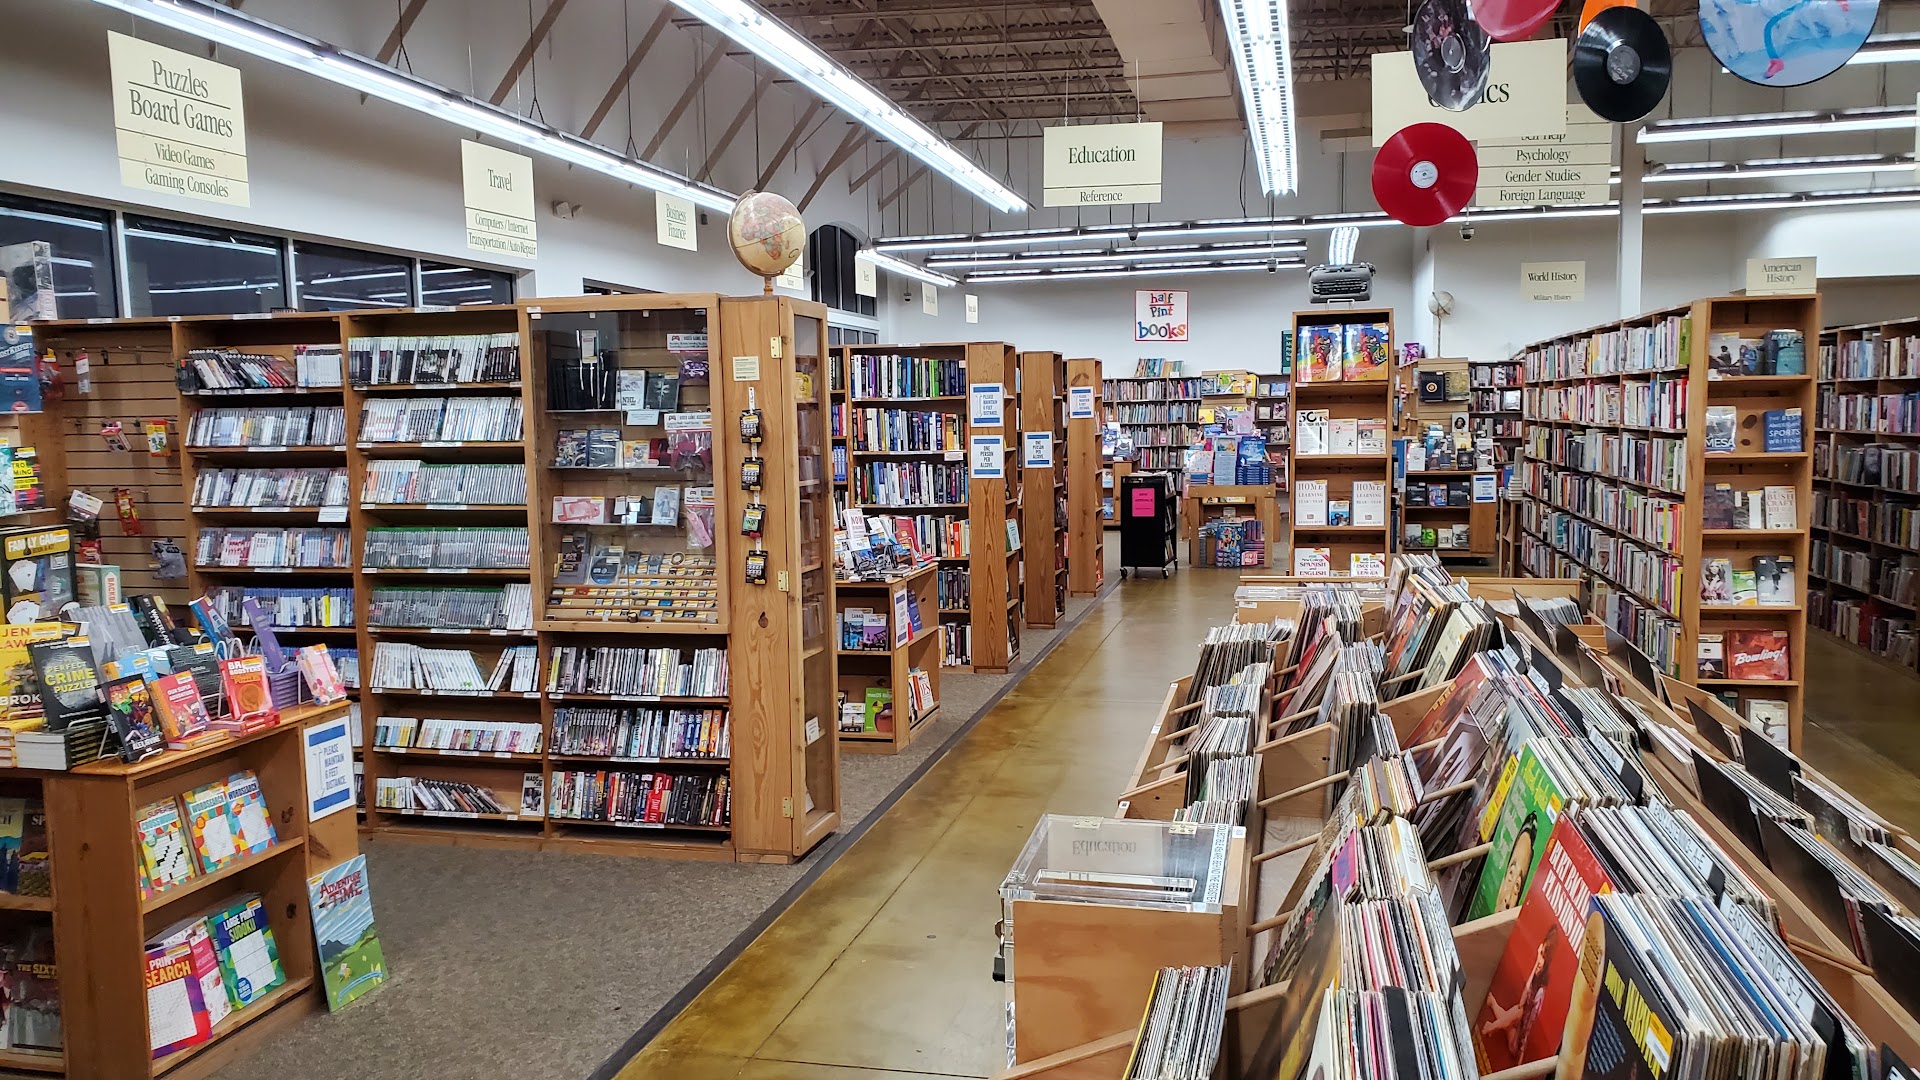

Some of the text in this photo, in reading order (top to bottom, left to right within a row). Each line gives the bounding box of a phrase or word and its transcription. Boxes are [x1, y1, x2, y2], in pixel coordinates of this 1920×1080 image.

[152, 59, 209, 98] Puzzles
[129, 88, 233, 138] Board Games
[154, 142, 215, 170] Video Games
[1068, 145, 1136, 164] Education
[1516, 148, 1571, 164] Psychology
[145, 167, 229, 198] Gaming Consoles
[487, 168, 513, 192] Travel
[1505, 168, 1581, 183] Gender Studies
[1079, 190, 1123, 203] Reference
[1500, 188, 1586, 204] Foreign Language
[1761, 262, 1802, 273] American
[1527, 271, 1579, 283] World History
[1766, 273, 1797, 284] History
[1150, 292, 1174, 304] half
[1150, 306, 1174, 318] Pint
[1137, 321, 1187, 339] books
[1769, 429, 1800, 437] SPORTS
[1298, 483, 1324, 491] HOME
[1356, 482, 1382, 491] HOME
[2, 627, 30, 638] JEN
[150, 608, 171, 645] WASTELAN
[1734, 645, 1786, 666] Bowling!
[48, 661, 88, 673] PERFECT
[45, 667, 96, 686] CRIME
[0, 693, 42, 706] BROK
[323, 743, 339, 757] PLEASE
[324, 753, 345, 768] MAINTAIN
[325, 766, 339, 778] 6 FEET
[228, 782, 258, 800] WORDSEARCH
[31, 815, 46, 826] SP
[319, 869, 362, 899] ADVENTURE
[328, 880, 363, 907] TIME
[223, 913, 241, 931] LARGE
[229, 918, 257, 943] SUDOKU
[32, 963, 58, 976] SIXT
[149, 954, 178, 971] PRINT
